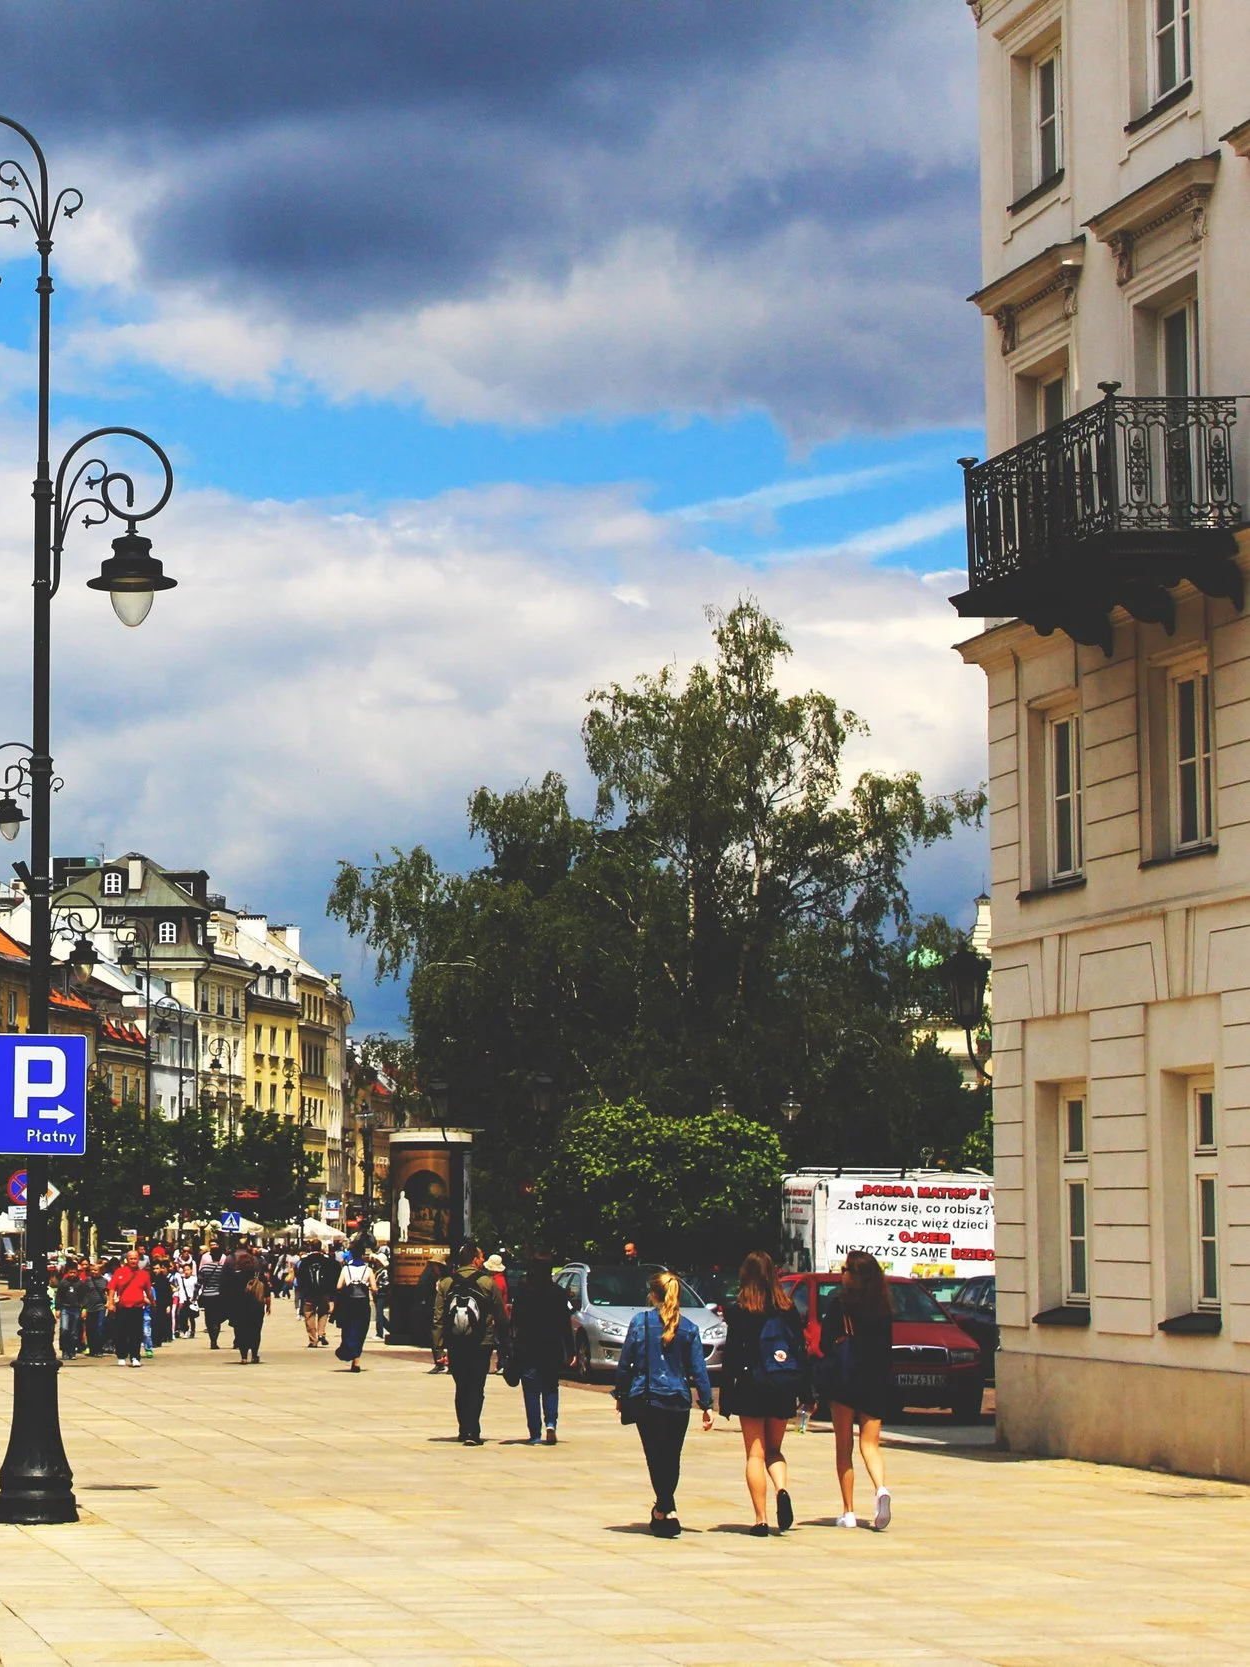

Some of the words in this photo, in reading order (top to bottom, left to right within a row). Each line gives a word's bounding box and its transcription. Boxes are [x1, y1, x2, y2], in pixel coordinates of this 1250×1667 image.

[13, 1045, 67, 1119] P
[27, 1128, 77, 1147] Płatny
[838, 1199, 898, 1212] Zastanów
[901, 1201, 922, 1216] się,
[926, 1204, 941, 1213] co
[952, 1218, 988, 1231] dzieci
[887, 1233, 895, 1242] z
[911, 1247, 947, 1259] SAME
